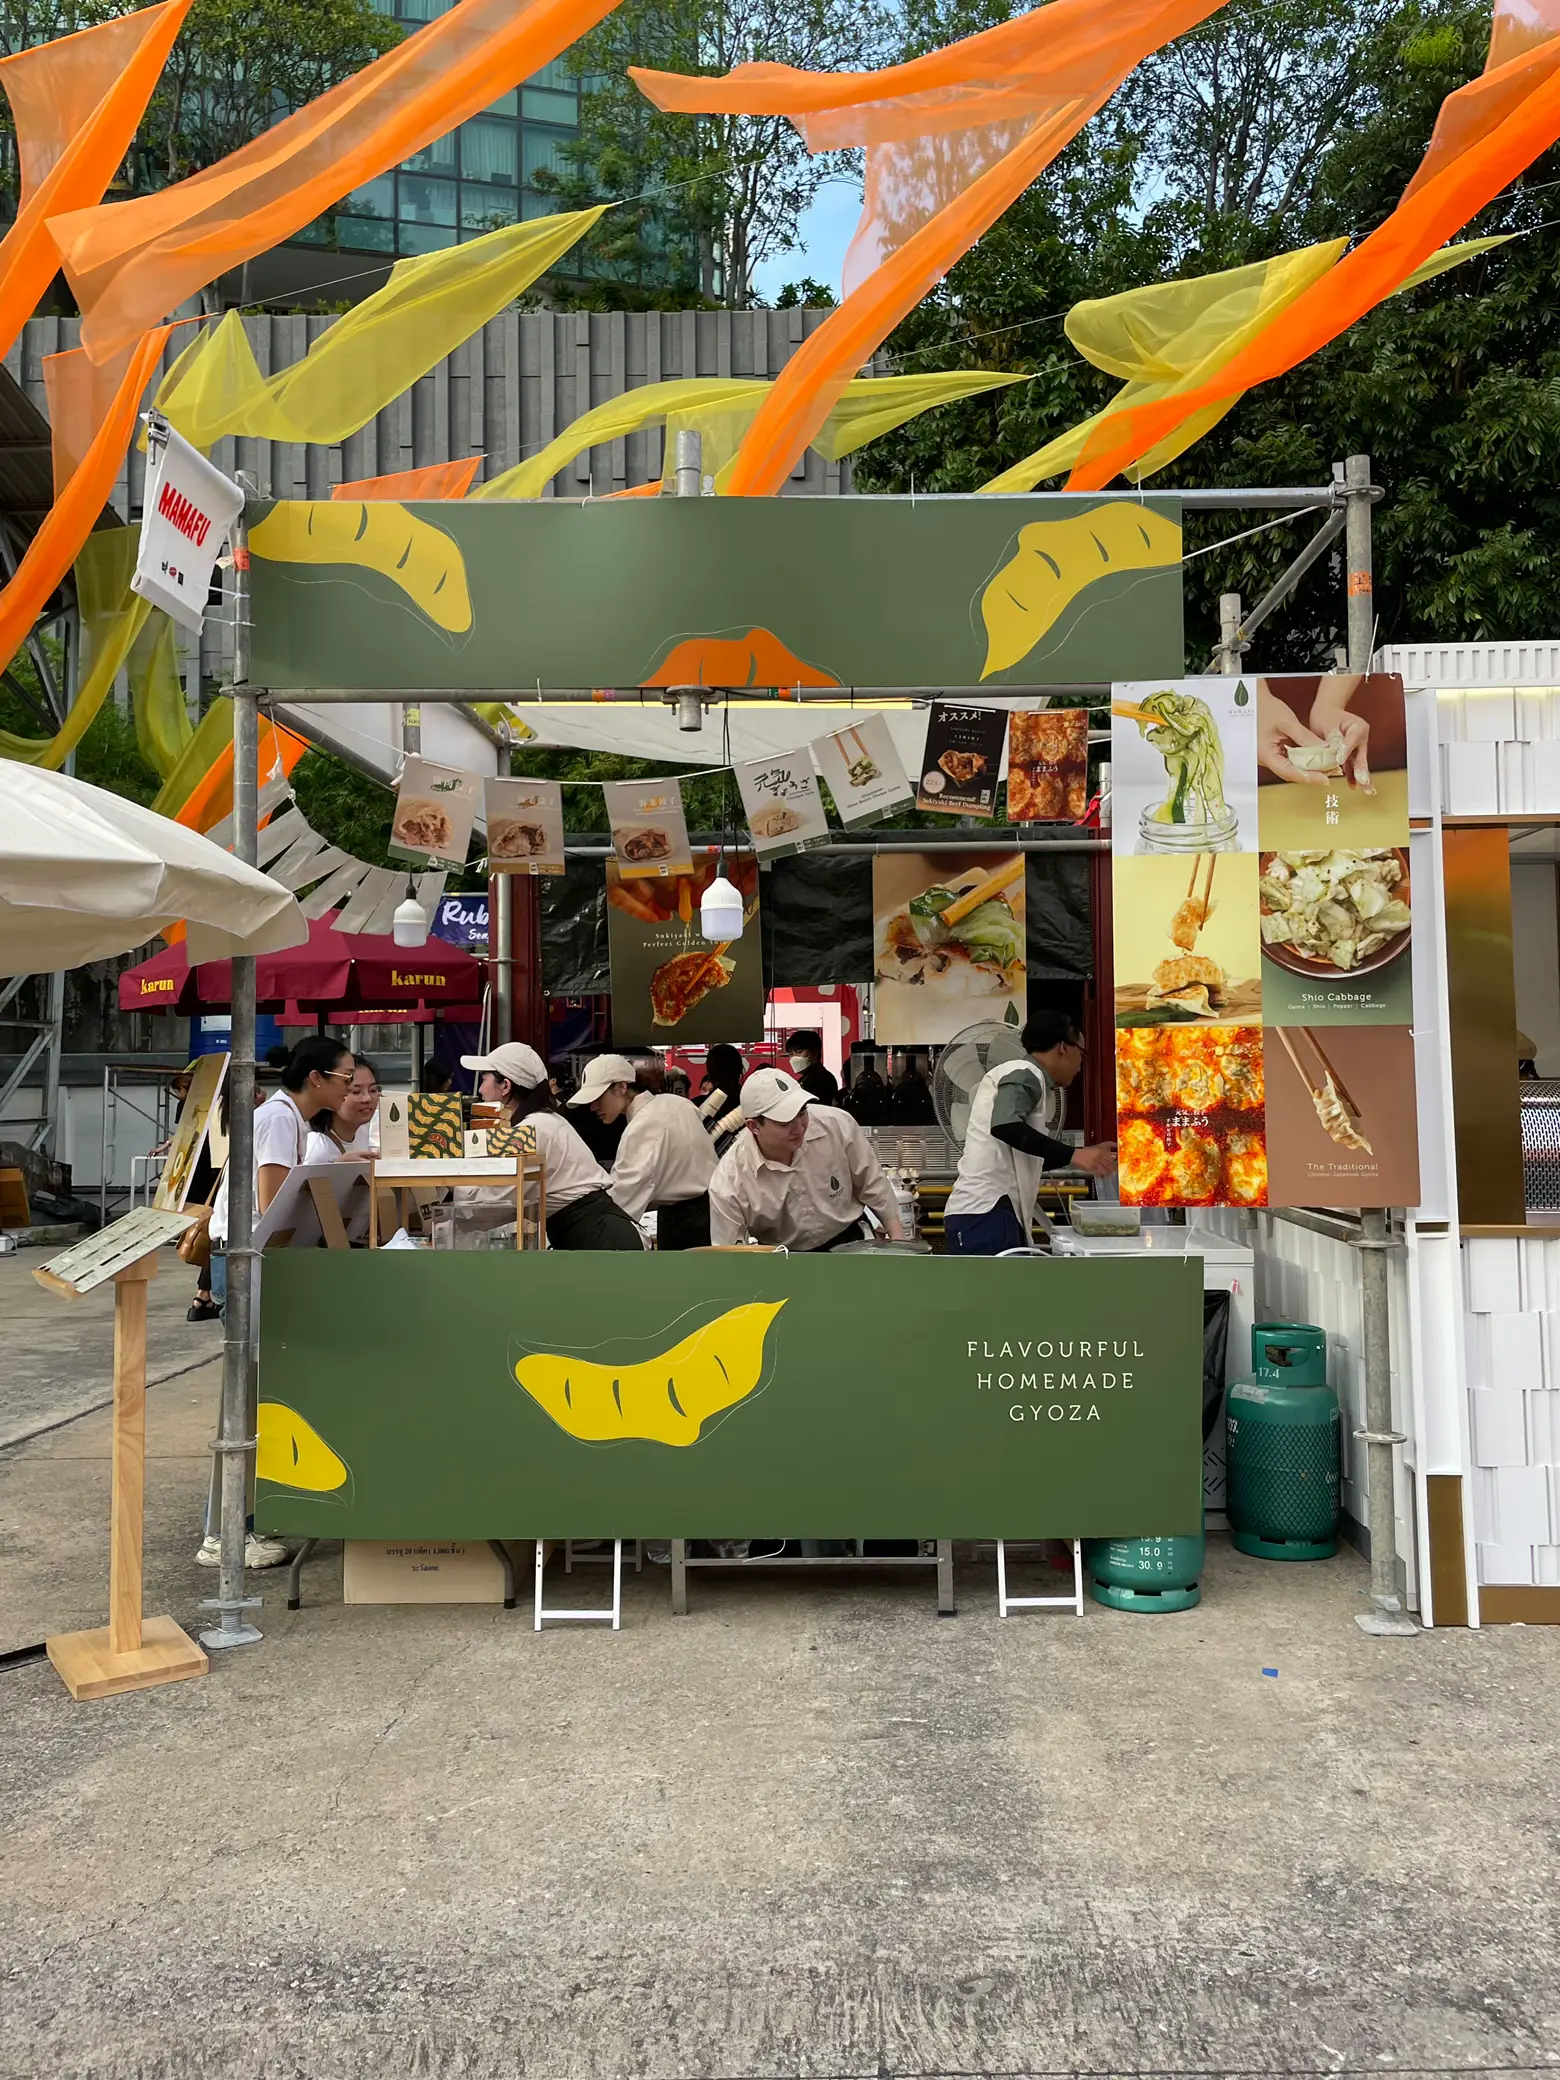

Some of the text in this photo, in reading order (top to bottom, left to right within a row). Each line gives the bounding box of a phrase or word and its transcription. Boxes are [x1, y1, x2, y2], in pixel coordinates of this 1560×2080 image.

[158, 481, 211, 547] MAMAFU
[937, 711, 982, 723] オススメ!
[922, 797, 949, 806] Sukiyaki
[962, 802, 992, 811] Dumpling
[938, 793, 977, 802] Recommend!
[1325, 794, 1340, 825] 技術
[391, 970, 446, 987] karun
[140, 977, 174, 995] karun
[1301, 992, 1372, 1003] Shio Cabbage
[1172, 1116, 1209, 1127] ままふう
[1307, 1163, 1379, 1171] The Traditional
[967, 1341, 1144, 1358] FLAVOURFUL
[1258, 1367, 1280, 1379] 17.4
[977, 1373, 1133, 1389] HOMEMADE
[1009, 1404, 1101, 1421] GYOZA
[1139, 1547, 1161, 1557] 15.0
